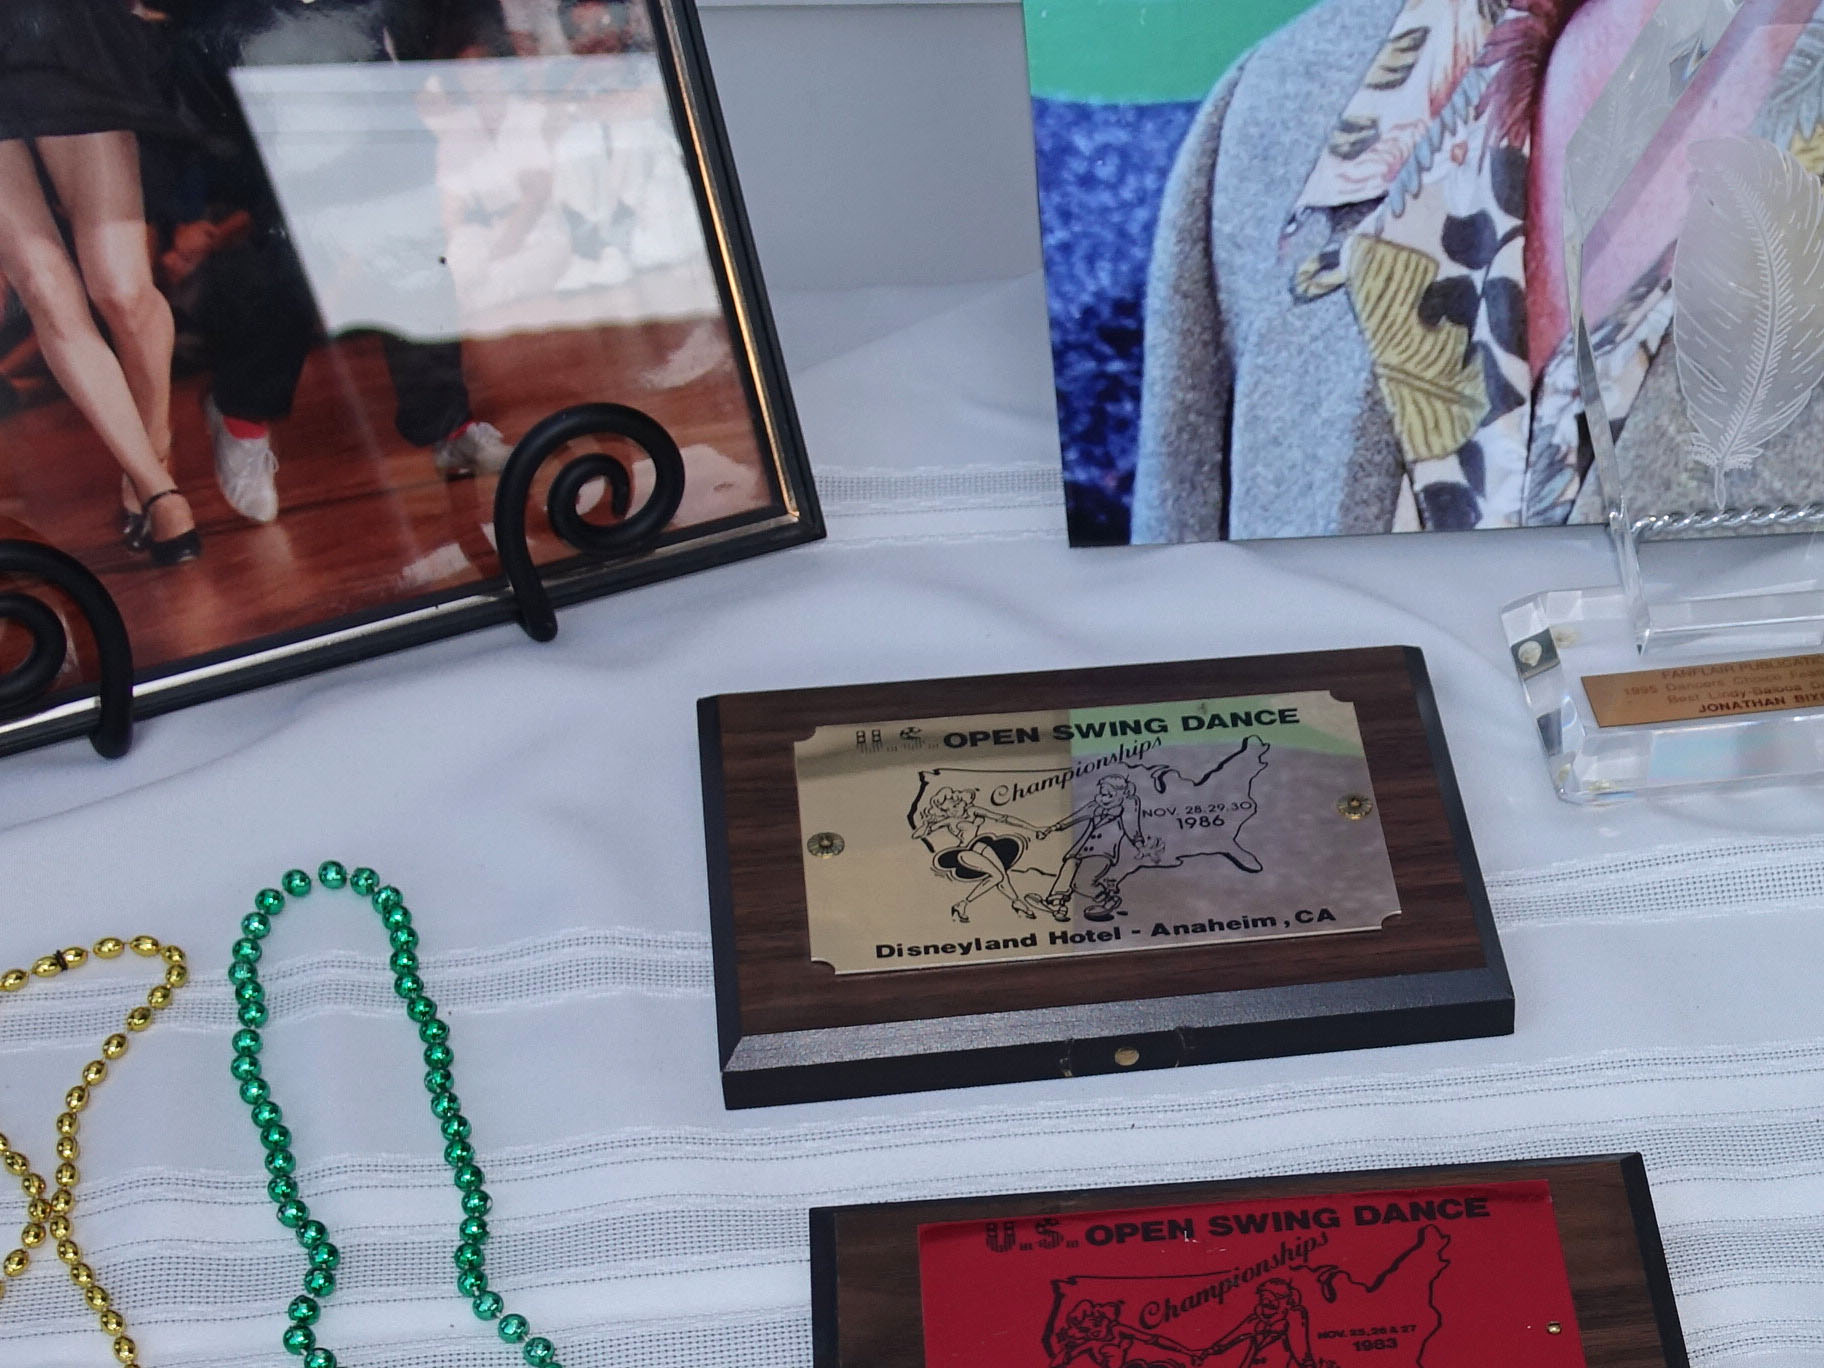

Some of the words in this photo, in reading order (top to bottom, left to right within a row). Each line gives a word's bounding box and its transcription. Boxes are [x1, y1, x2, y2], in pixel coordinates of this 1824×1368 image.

[1699, 696, 1786, 714] JONATHAN
[943, 727, 1041, 749] OPEN
[1052, 716, 1169, 742] SWING
[1181, 708, 1301, 732] DANCE
[989, 735, 1163, 807] Championships
[1177, 814, 1225, 830] 1986
[874, 931, 1038, 960] Disneyland
[1048, 926, 1121, 947] Hotel
[1084, 1218, 1196, 1248] OPEN
[1208, 1207, 1341, 1237] SWING
[1353, 1197, 1491, 1227] DANCE
[1138, 1230, 1329, 1330] Championships
[1352, 1337, 1399, 1352] 1983
